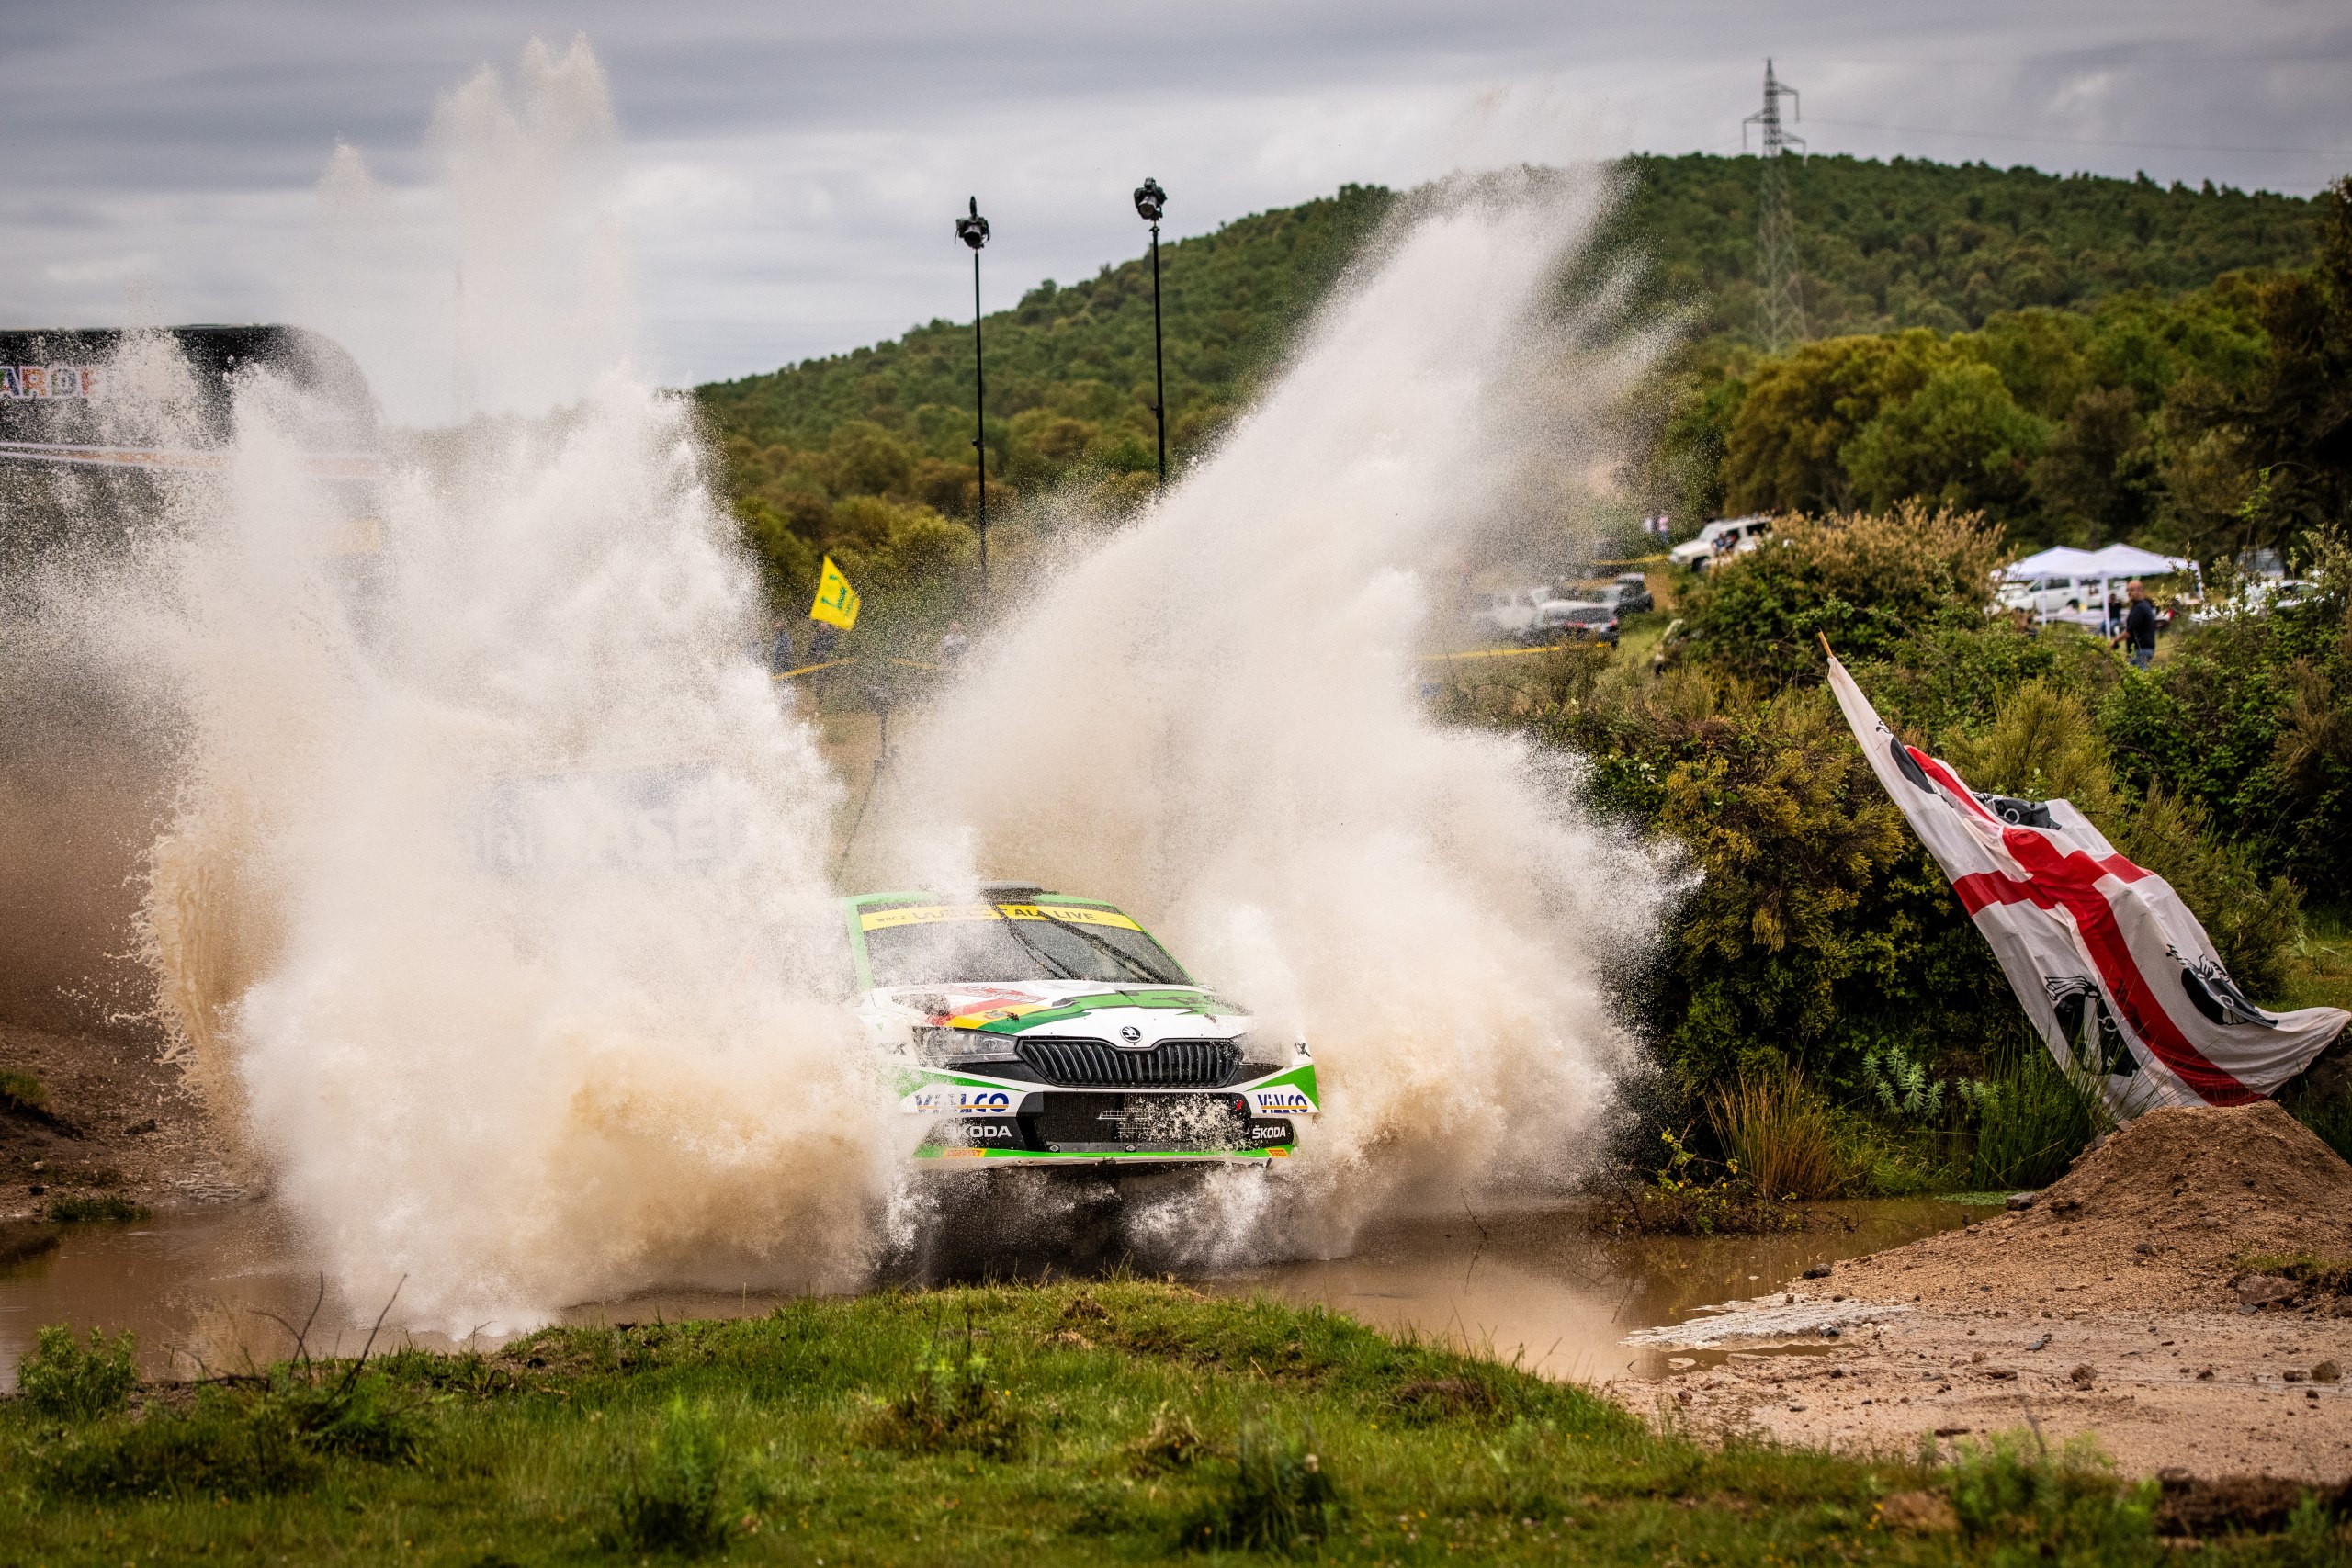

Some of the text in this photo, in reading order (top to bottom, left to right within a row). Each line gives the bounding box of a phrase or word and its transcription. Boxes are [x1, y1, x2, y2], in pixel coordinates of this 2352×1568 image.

[1053, 909, 1098, 921] LIVE
[956, 1123, 1012, 1138] KODA
[1252, 1124, 1286, 1140] ŠKODA
